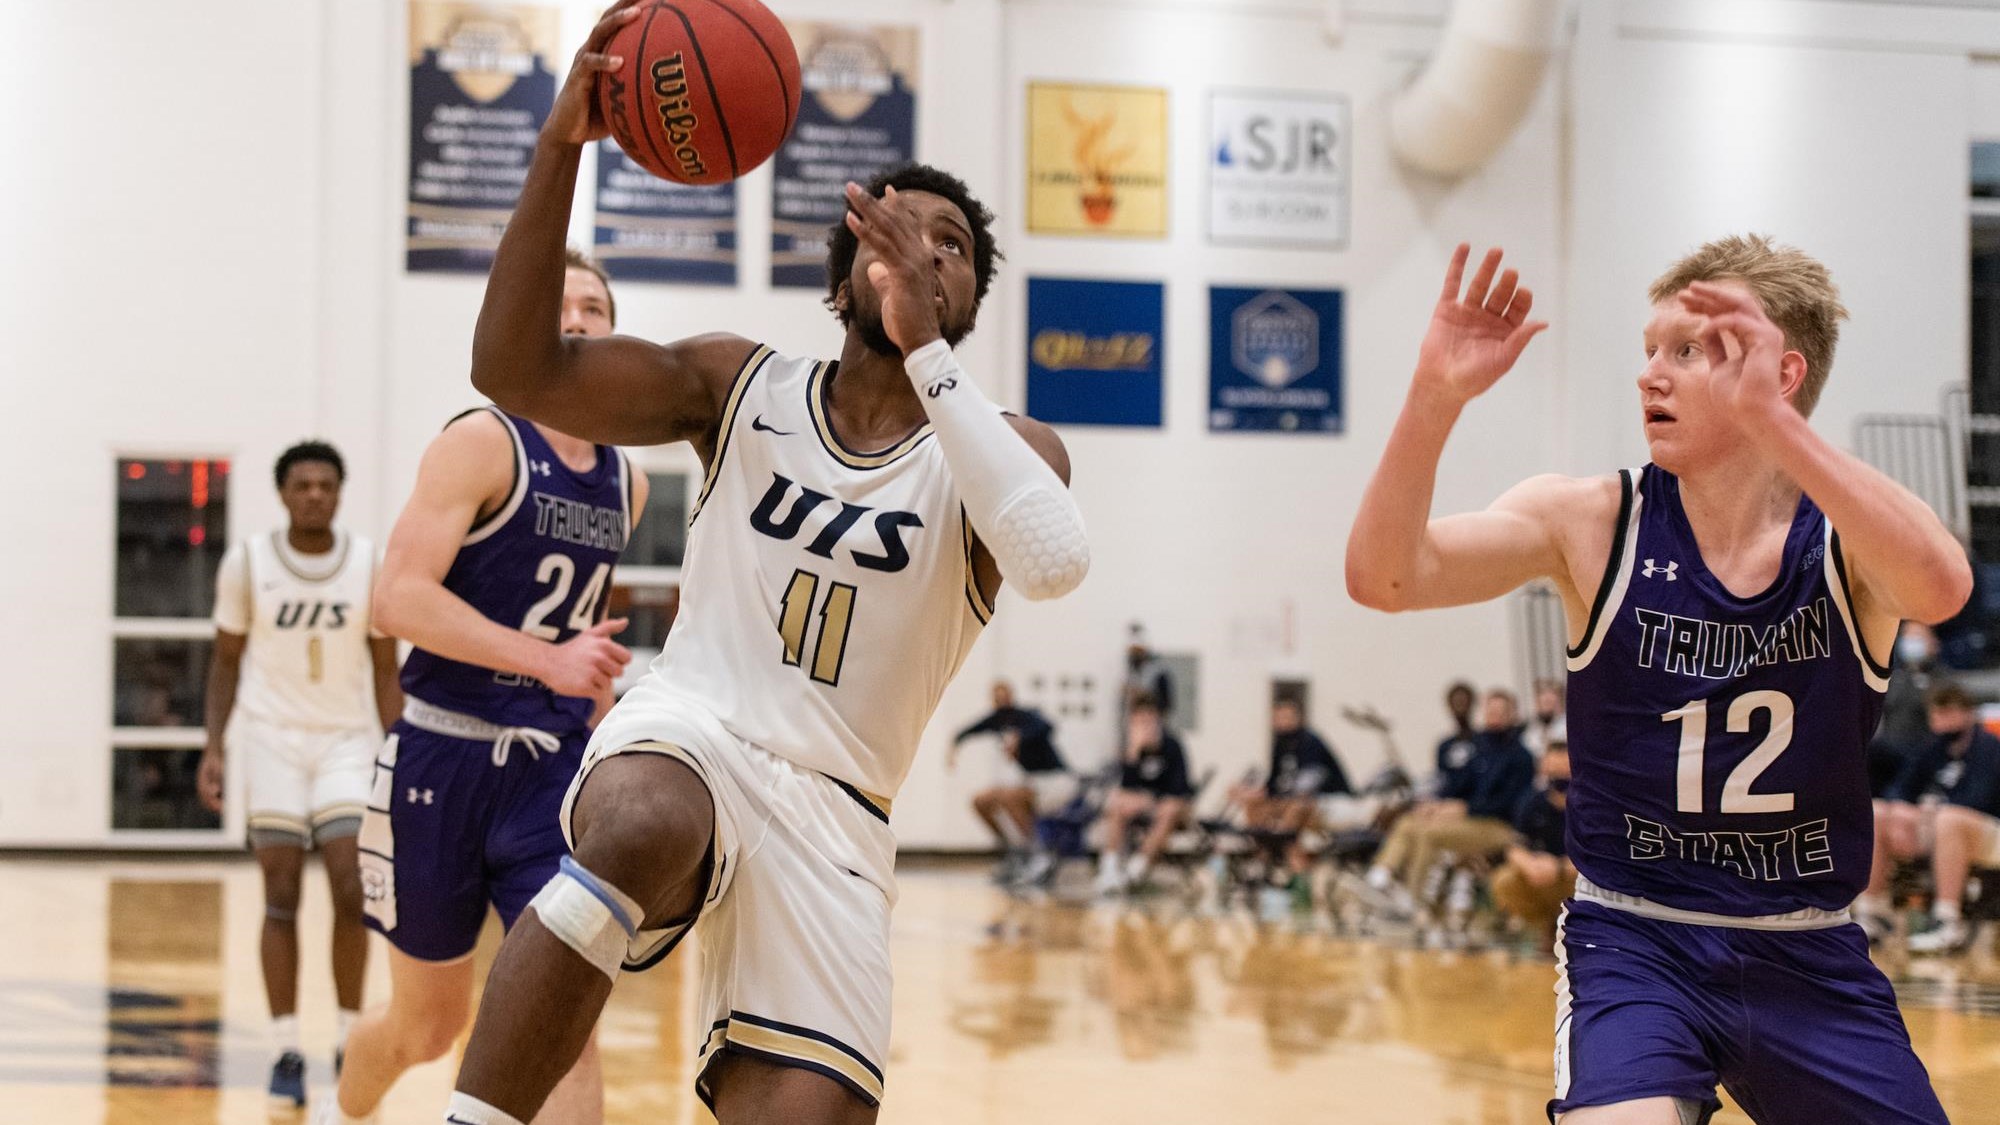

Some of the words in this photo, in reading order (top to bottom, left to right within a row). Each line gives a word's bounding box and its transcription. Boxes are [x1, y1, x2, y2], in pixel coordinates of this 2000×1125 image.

[650, 50, 708, 177] Wilson
[1246, 115, 1339, 175] SJR
[532, 491, 626, 551] TRUMAN
[750, 471, 925, 573] UIS
[276, 602, 352, 630] UIS
[520, 553, 611, 642] 24
[777, 568, 858, 688] 11
[1634, 597, 1832, 680] TRUMAN
[308, 636, 323, 683] 1
[1660, 689, 1796, 815] 12
[1624, 813, 1835, 881] STATE
